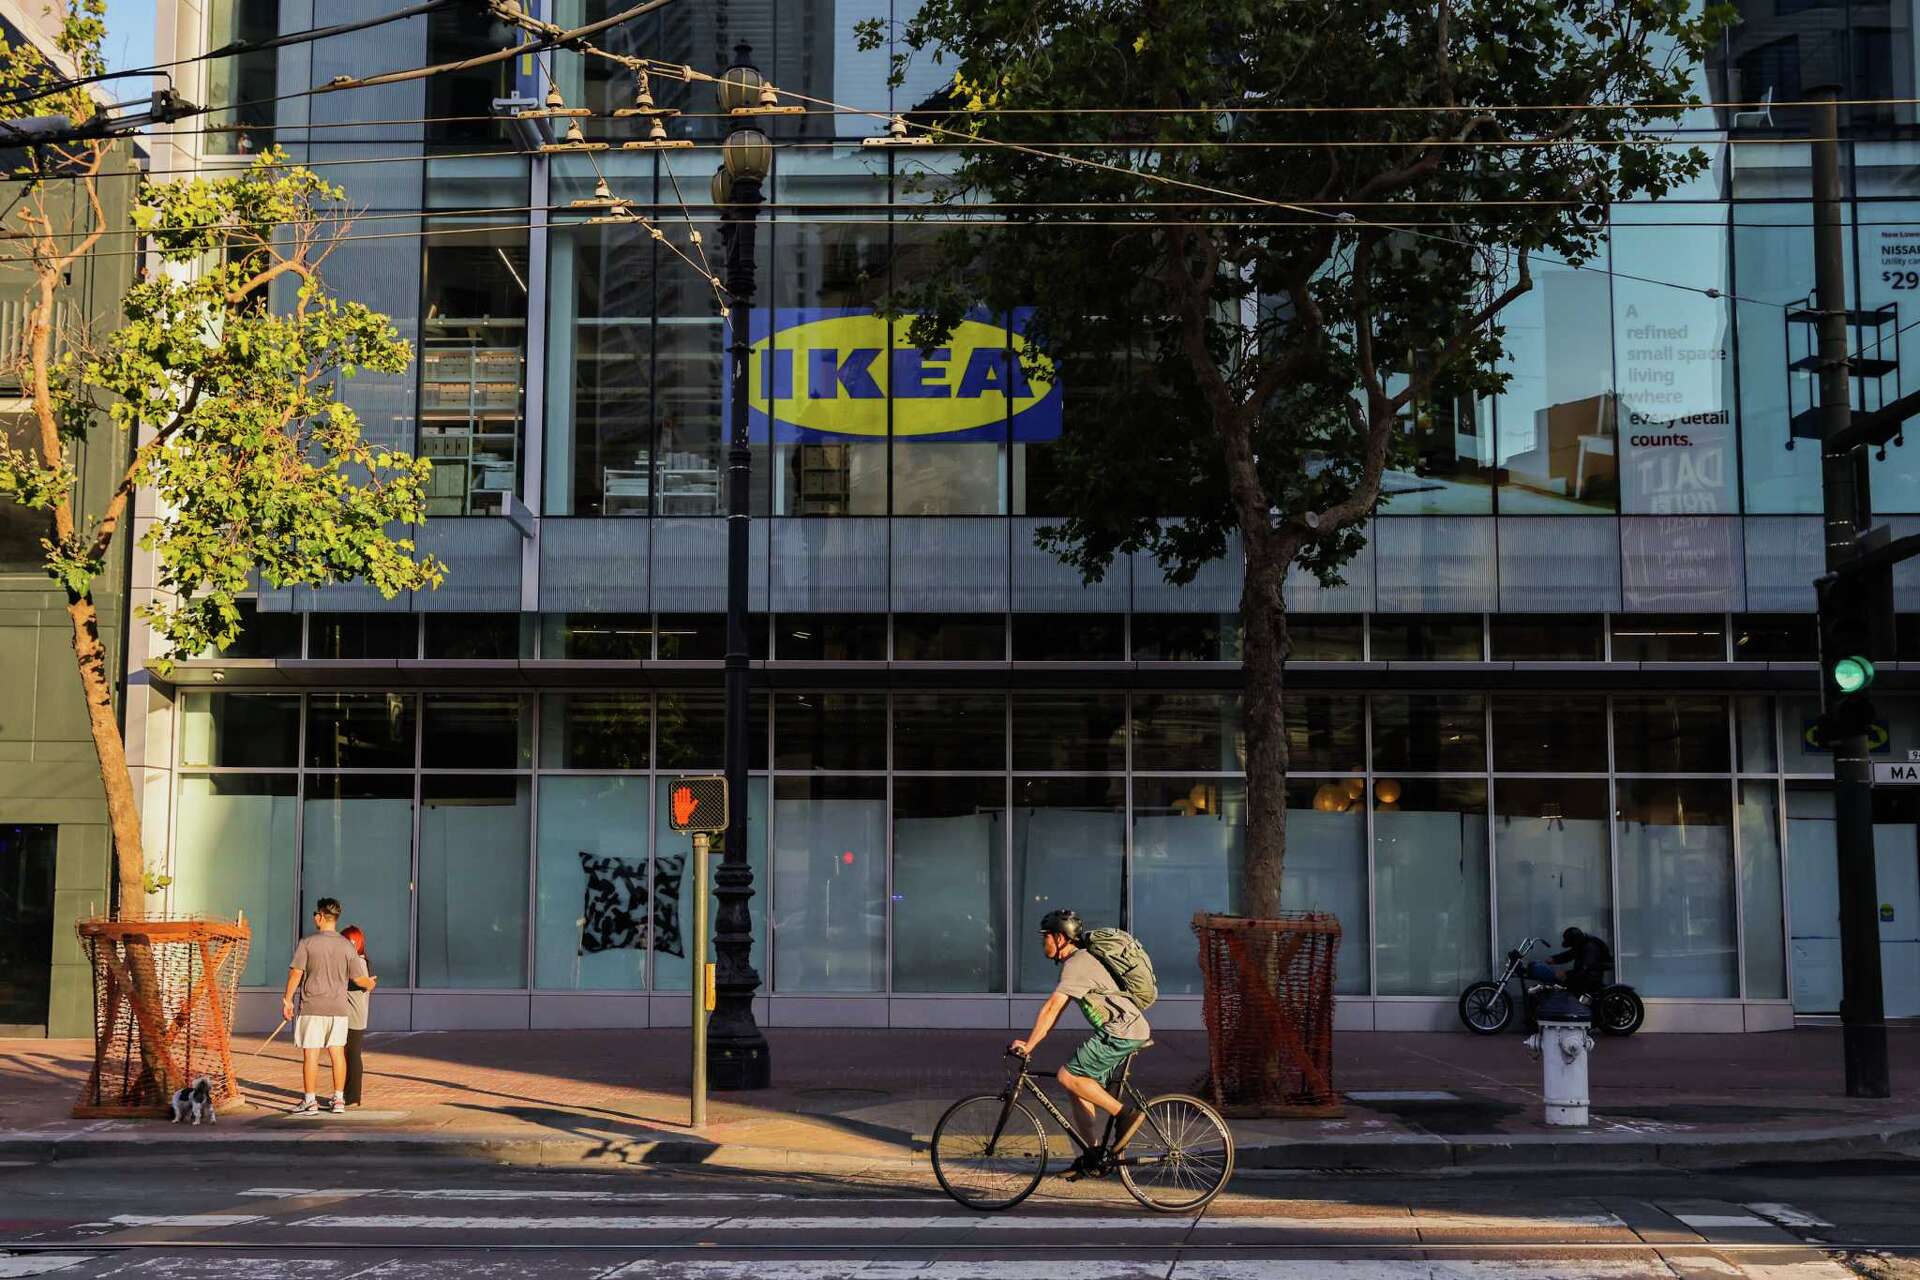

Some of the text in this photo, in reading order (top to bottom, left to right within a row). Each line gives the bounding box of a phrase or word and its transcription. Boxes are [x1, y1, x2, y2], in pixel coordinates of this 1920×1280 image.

[1625, 304, 1638, 318] A
[1627, 324, 1688, 340] refined
[1627, 346, 1727, 364] small space
[760, 348, 1035, 400] IKEA
[1628, 367, 1675, 386] living
[1630, 388, 1683, 404] where
[1681, 410, 1729, 425] detail
[1630, 433, 1694, 447] counts.
[1032, 1087, 1071, 1129] FORTIFIED
